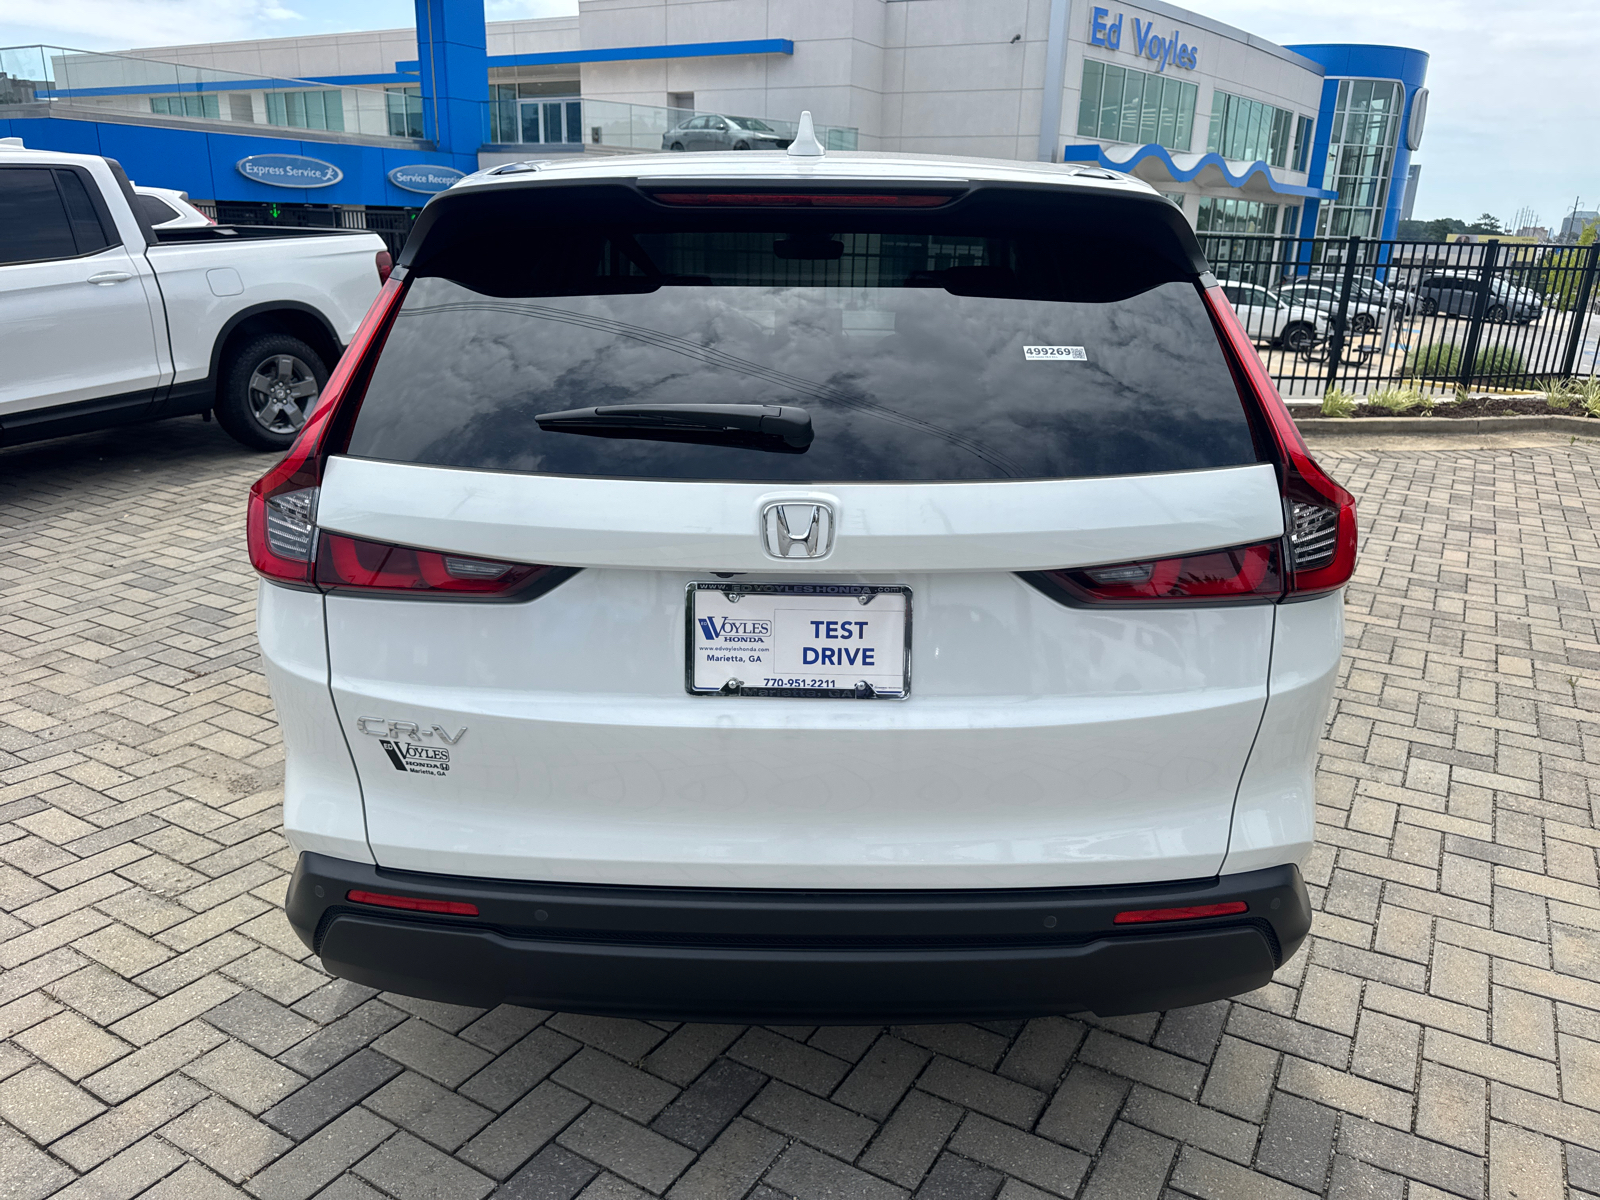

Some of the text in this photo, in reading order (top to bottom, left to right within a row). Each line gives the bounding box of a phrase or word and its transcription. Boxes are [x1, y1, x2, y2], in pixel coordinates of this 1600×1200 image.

[1087, 6, 1198, 72] Ed Voyles
[245, 162, 322, 178] Express Service
[396, 172, 427, 184] Service
[1026, 347, 1071, 356] 499269
[810, 621, 868, 639] TEST
[706, 654, 762, 664] Marietta, GA
[802, 647, 875, 666] DRIVE
[763, 678, 836, 688] 770-951-2211
[357, 715, 469, 745] CR-V
[405, 760, 440, 769] HONDA
[409, 767, 436, 776] Marietta,
